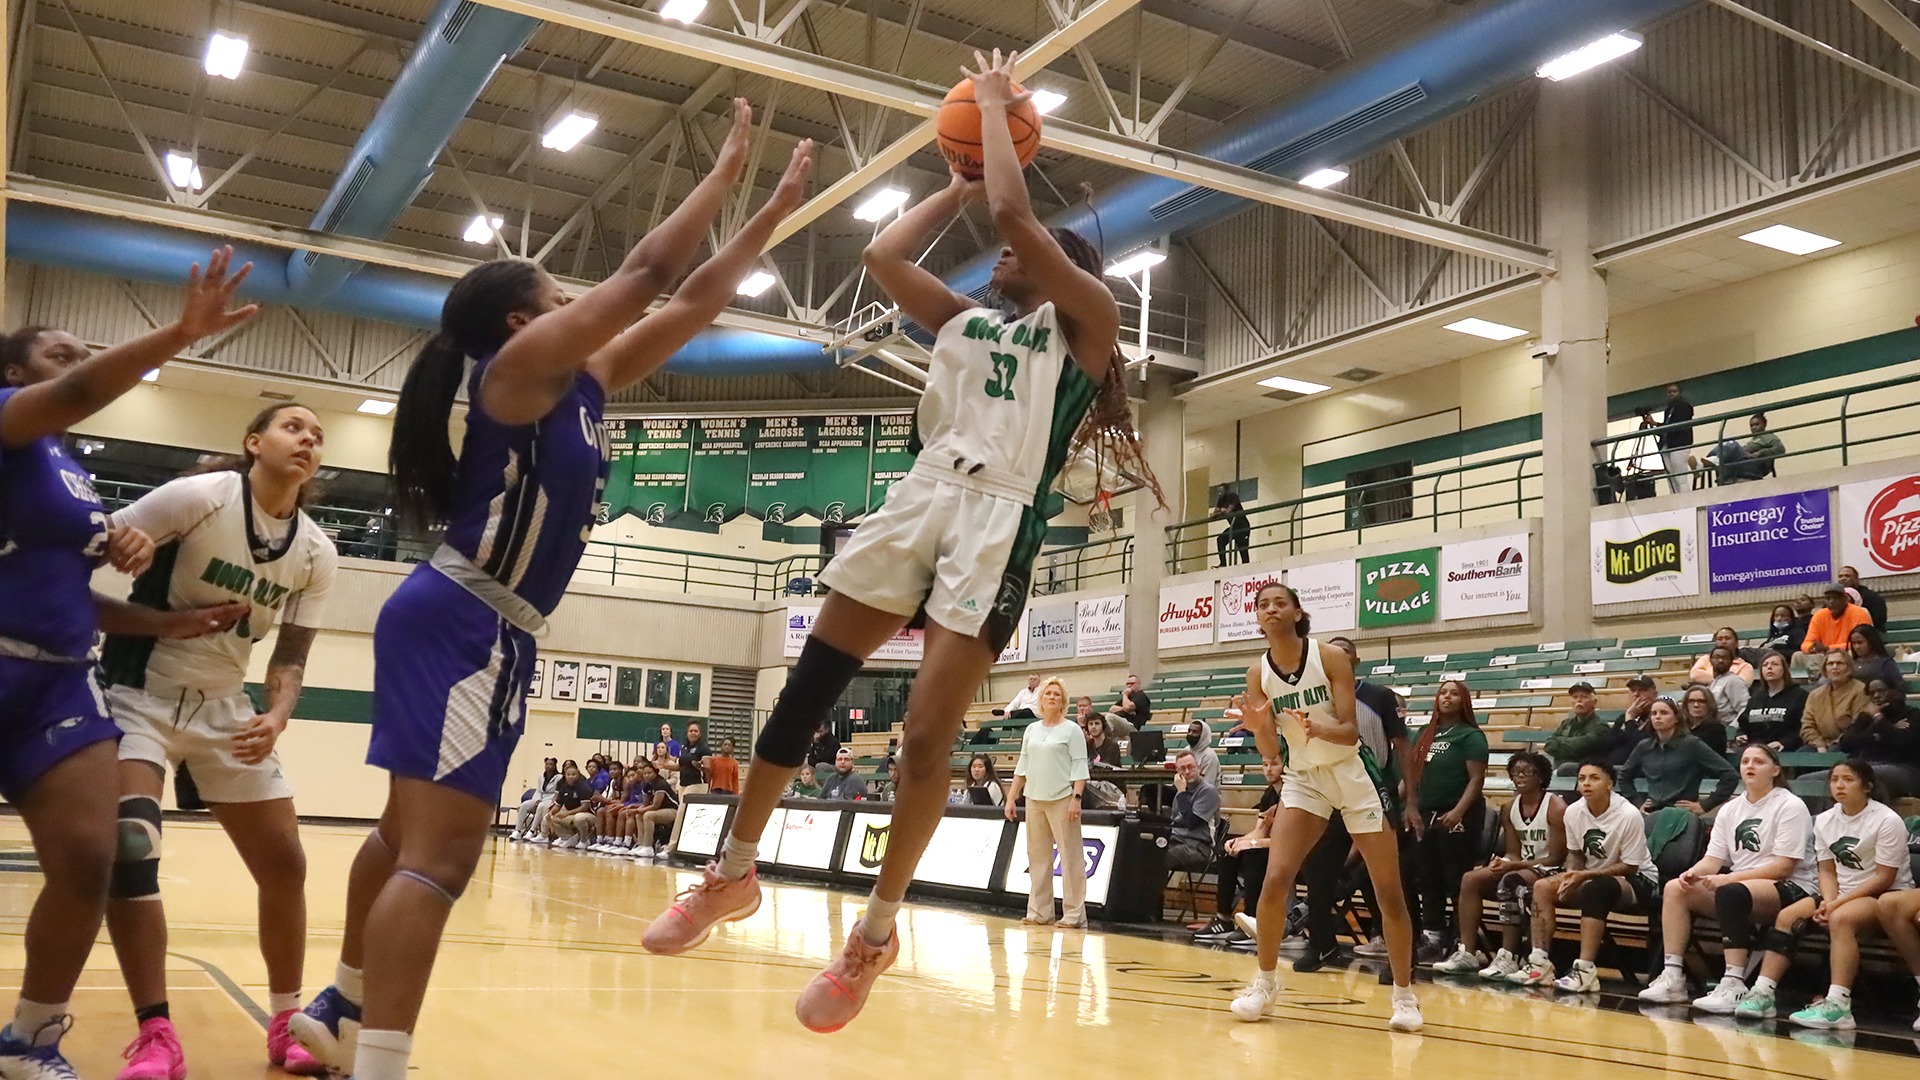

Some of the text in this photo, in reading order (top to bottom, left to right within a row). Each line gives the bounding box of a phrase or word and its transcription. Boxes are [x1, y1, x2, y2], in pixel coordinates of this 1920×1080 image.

[1012, 323, 1051, 353] OLIVE
[985, 352, 1017, 400] 32
[642, 420, 688, 429] WOMEN'S
[700, 419, 747, 429] WOMEN'S
[765, 417, 798, 428] MEN'S
[825, 416, 858, 426] MEN'S
[880, 416, 912, 426] WOME
[647, 429, 682, 439] TENNIS
[705, 429, 740, 439] TENNIS
[759, 427, 804, 438] LACROSSE
[818, 426, 864, 437] LACROSSE
[1711, 505, 1786, 528] Kornegay
[1800, 515, 1825, 524] Trusted
[1711, 526, 1788, 548] Insurance
[1461, 559, 1489, 569] Since 1901
[1366, 562, 1430, 585] PIZZA
[1712, 563, 1828, 583] kornegayinsurance.com
[1324, 585, 1341, 593] Electric
[1327, 590, 1354, 600] Corporation
[1460, 592, 1474, 601] Our
[1475, 590, 1498, 600] interest
[1499, 589, 1505, 597] is
[1365, 591, 1430, 614] VILLAGE
[1079, 600, 1123, 618] Best Used
[1181, 624, 1199, 632] SHAKES
[1273, 684, 1329, 715] MOUNT OLIVE
